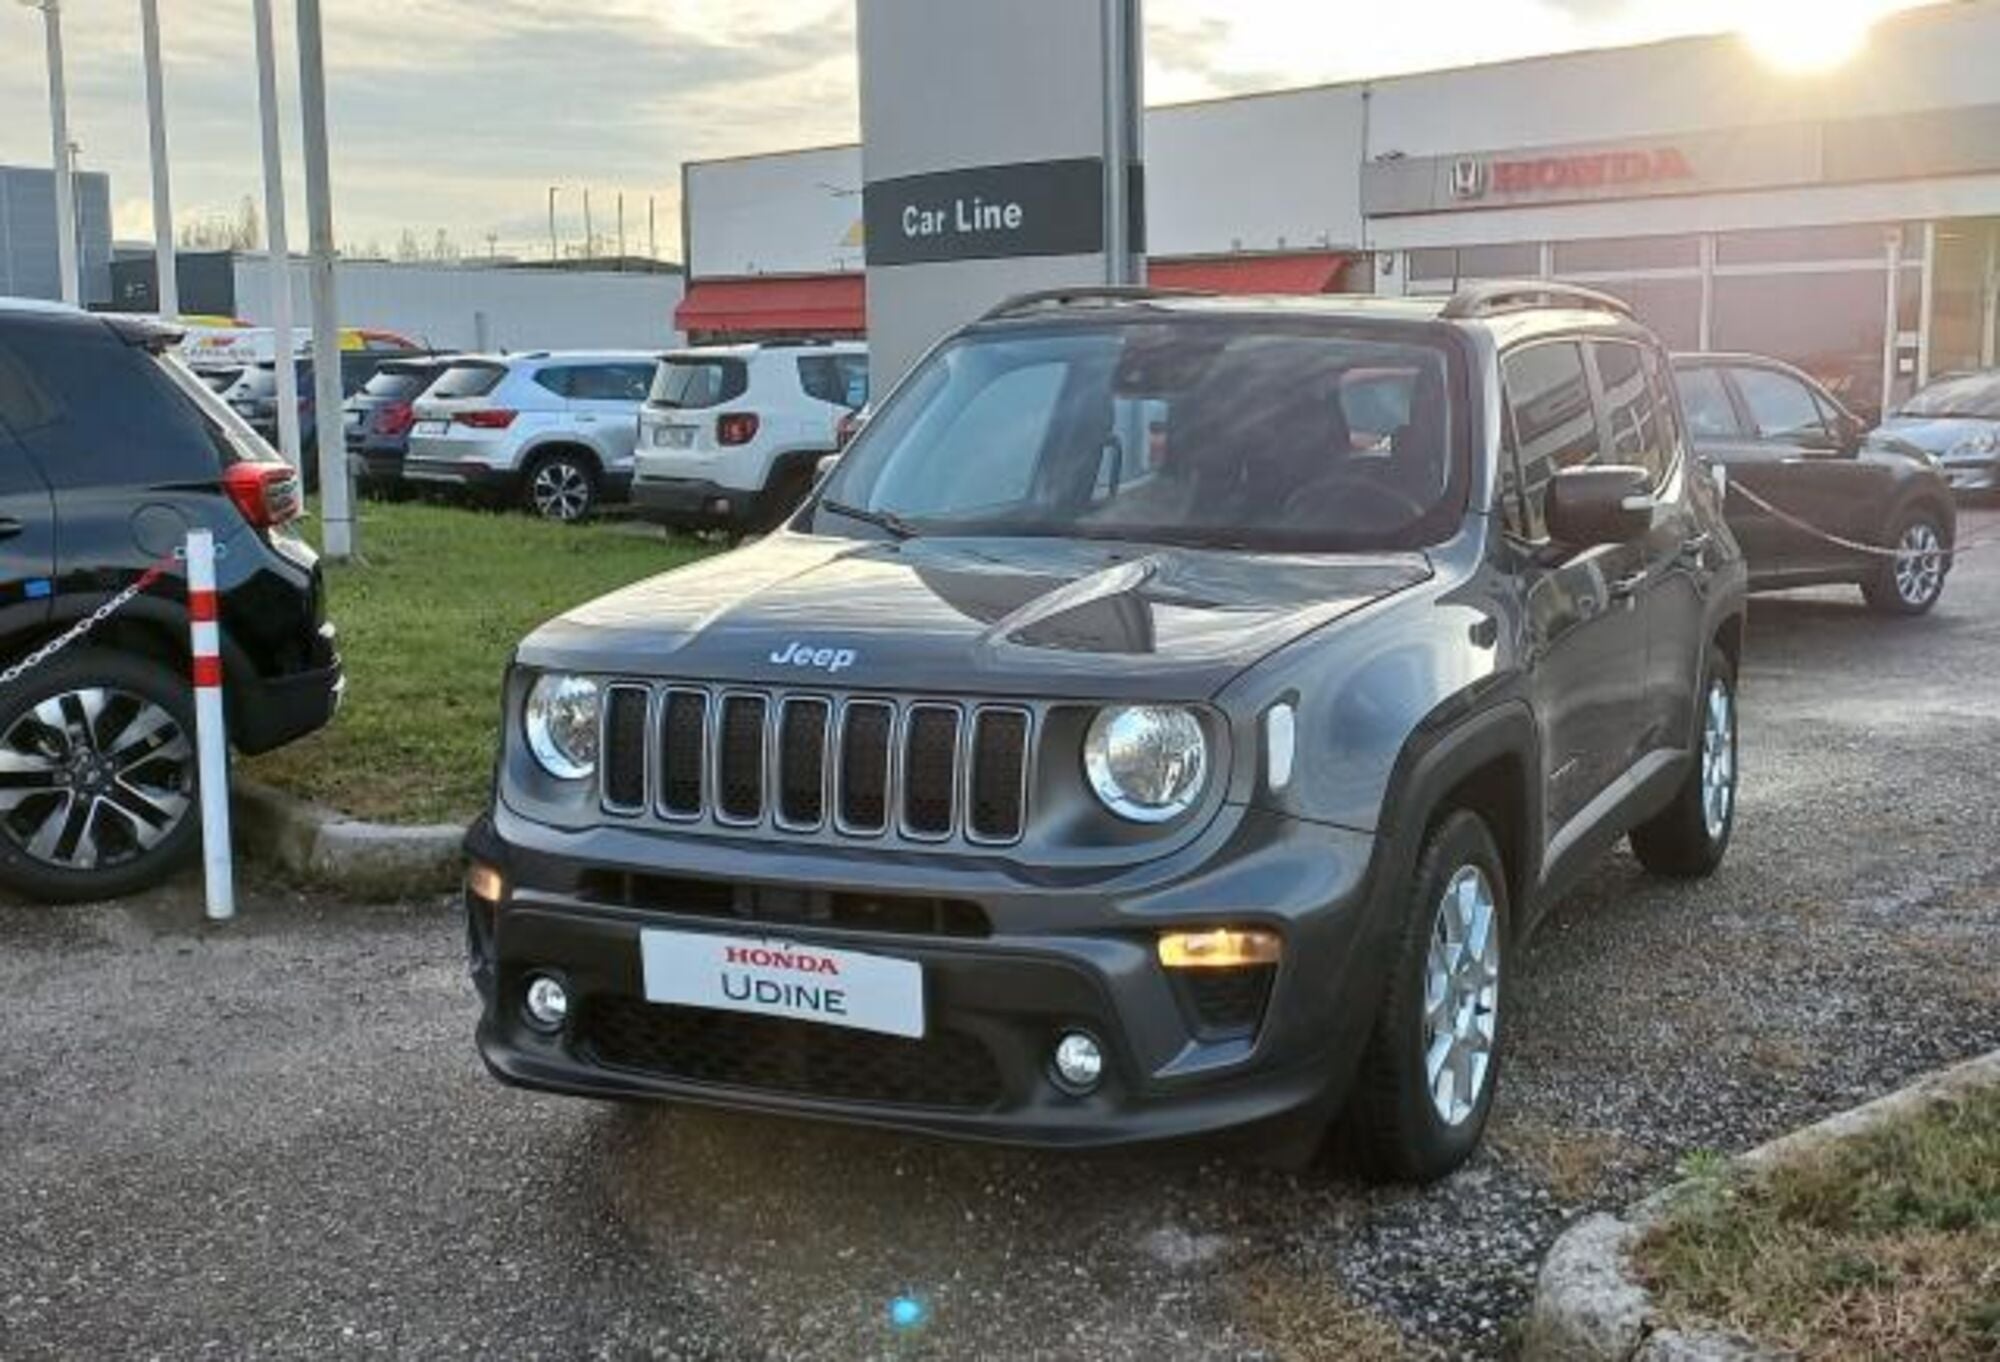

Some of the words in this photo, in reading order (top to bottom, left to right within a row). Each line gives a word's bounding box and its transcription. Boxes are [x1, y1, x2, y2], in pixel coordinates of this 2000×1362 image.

[1493, 147, 1696, 193] HONDA
[902, 204, 946, 237] Car
[955, 197, 1024, 232] Line
[769, 641, 857, 674] Jeep
[724, 946, 840, 976] HONDA
[720, 972, 849, 1016] UDINE
